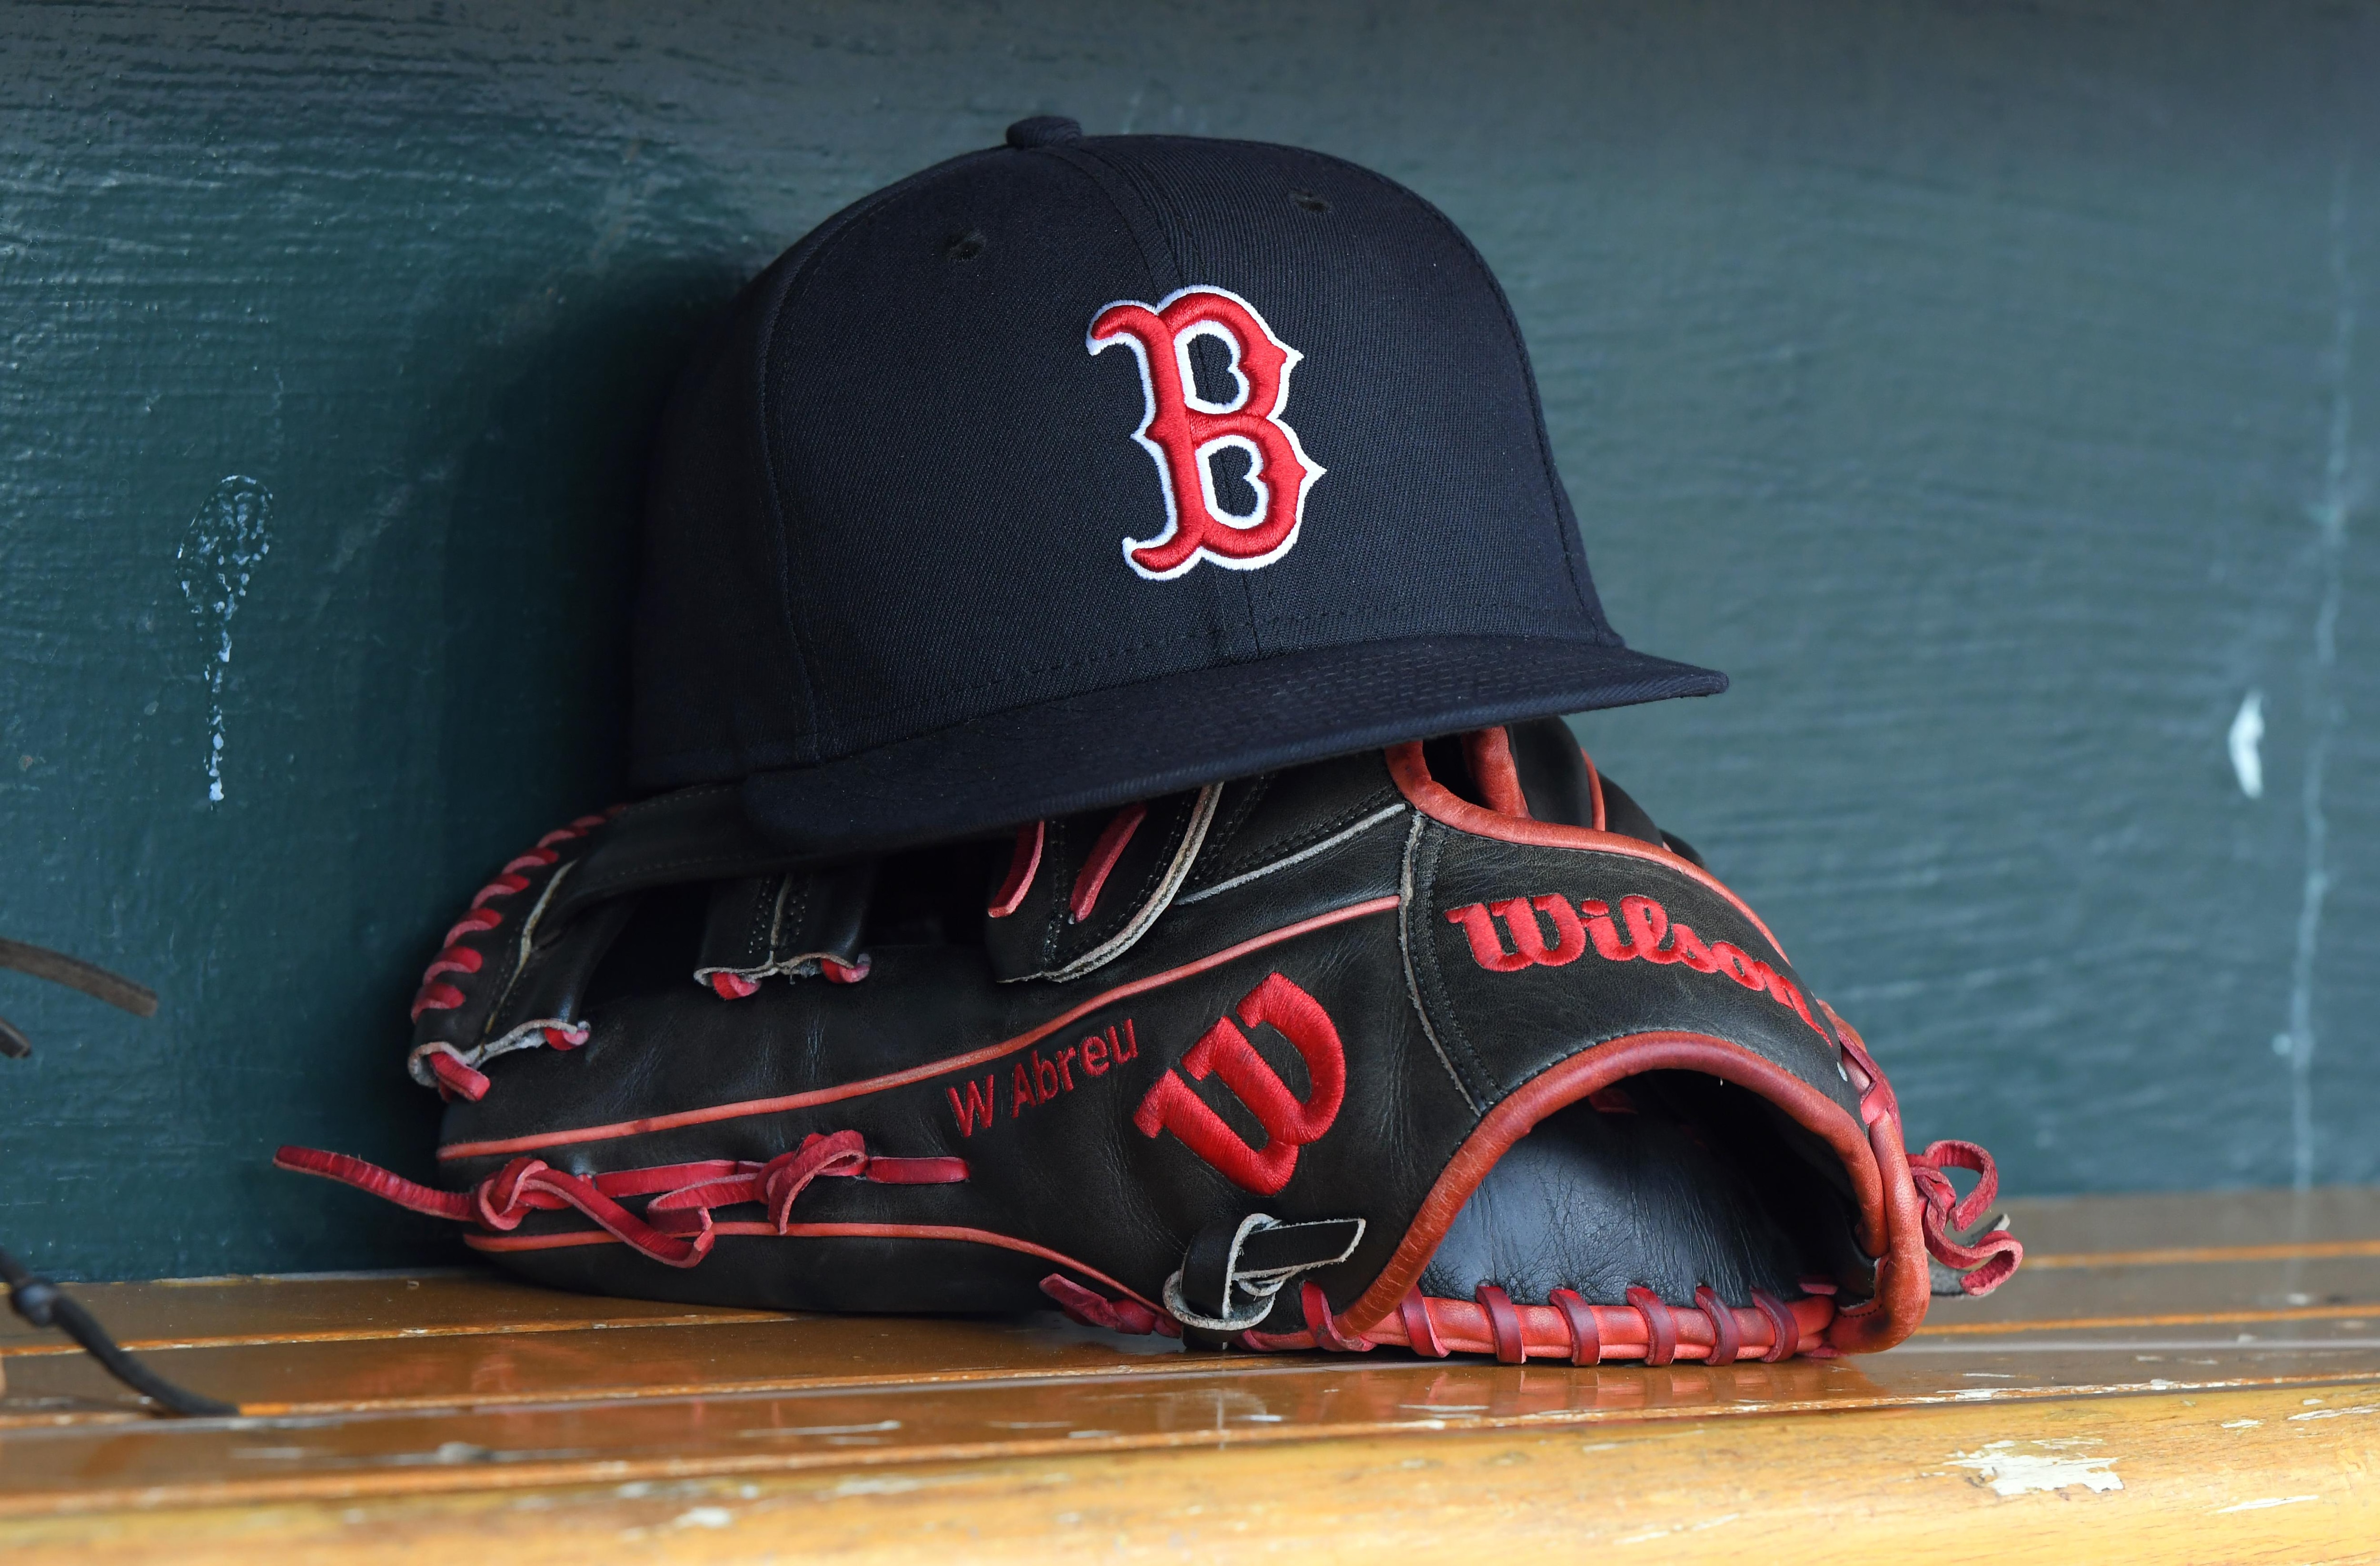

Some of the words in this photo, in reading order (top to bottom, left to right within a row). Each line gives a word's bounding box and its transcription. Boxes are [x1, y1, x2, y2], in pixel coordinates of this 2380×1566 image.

[1086, 284, 1327, 580] B
[1445, 894, 1833, 1047] Wilson
[947, 1075, 993, 1137] W
[1012, 1018, 1138, 1117] Abreu
[1133, 972, 1346, 1196] W
